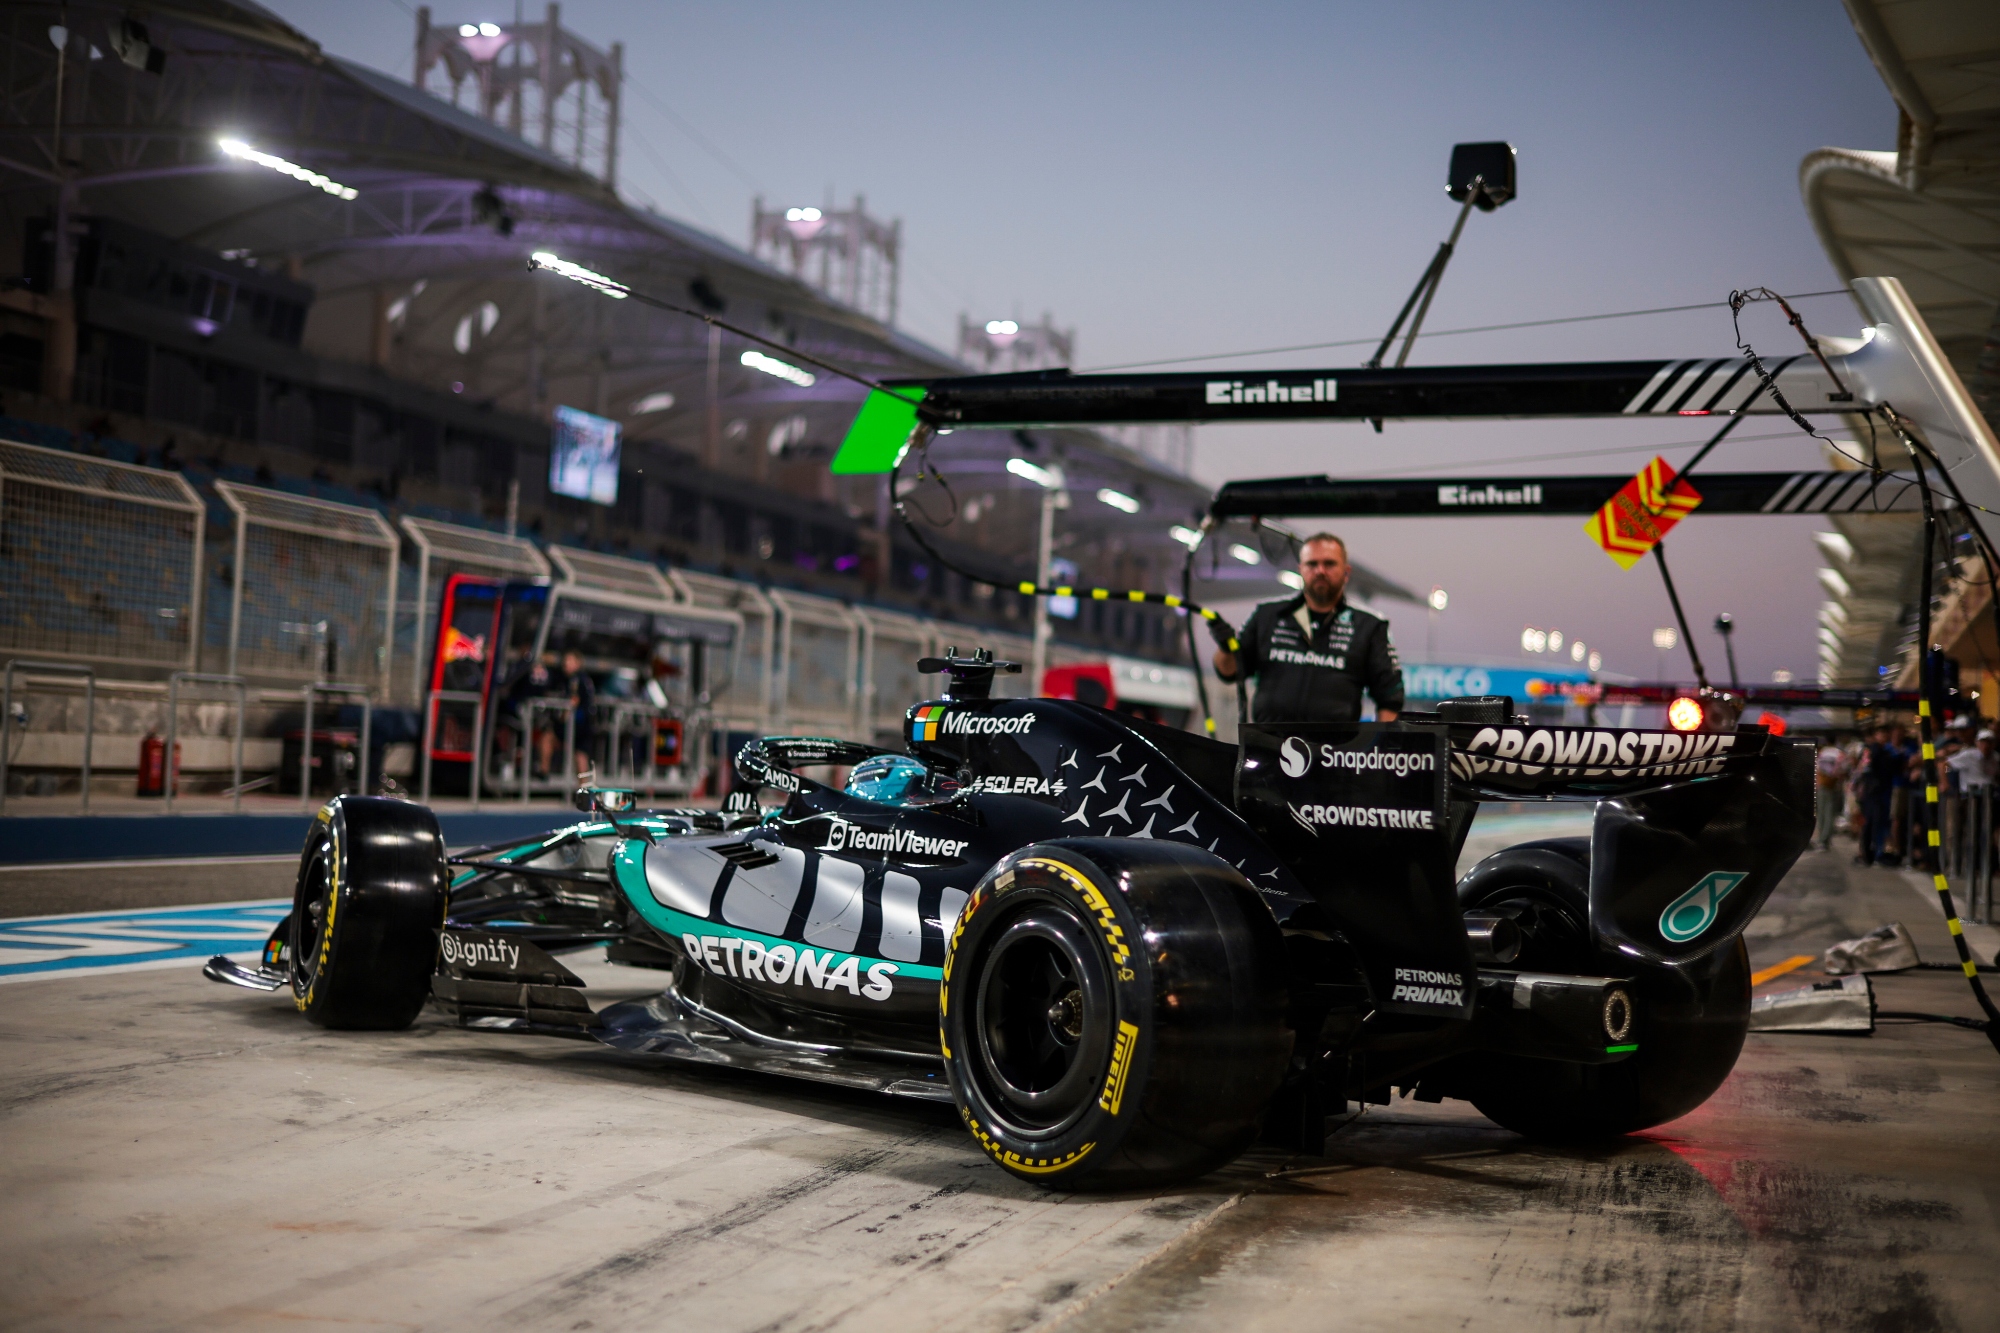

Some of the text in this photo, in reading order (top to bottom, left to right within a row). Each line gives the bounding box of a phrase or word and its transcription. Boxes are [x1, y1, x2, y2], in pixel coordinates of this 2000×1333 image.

[1205, 379, 1338, 404] Einhell
[1437, 484, 1542, 506] Einhell
[1618, 518, 1637, 538] ON
[1269, 648, 1345, 669] PETRONAS
[942, 711, 1036, 734] Microsoft
[793, 750, 828, 758] Snapdragon
[1320, 743, 1434, 777] Snapdragon
[1469, 727, 1736, 776] CROWDSTRIKE
[764, 768, 790, 788] AMD
[982, 776, 1050, 795] SOLERA
[1300, 804, 1434, 830] CROWDSTRIKE
[848, 825, 969, 857] TeamViewer
[1258, 887, 1289, 896] -Benz
[682, 933, 901, 1001] PETRONAS
[1395, 968, 1462, 986] PETRONAS
[1392, 985, 1465, 1007] PRIMAX
[1099, 1019, 1139, 1115] PIRELLI
